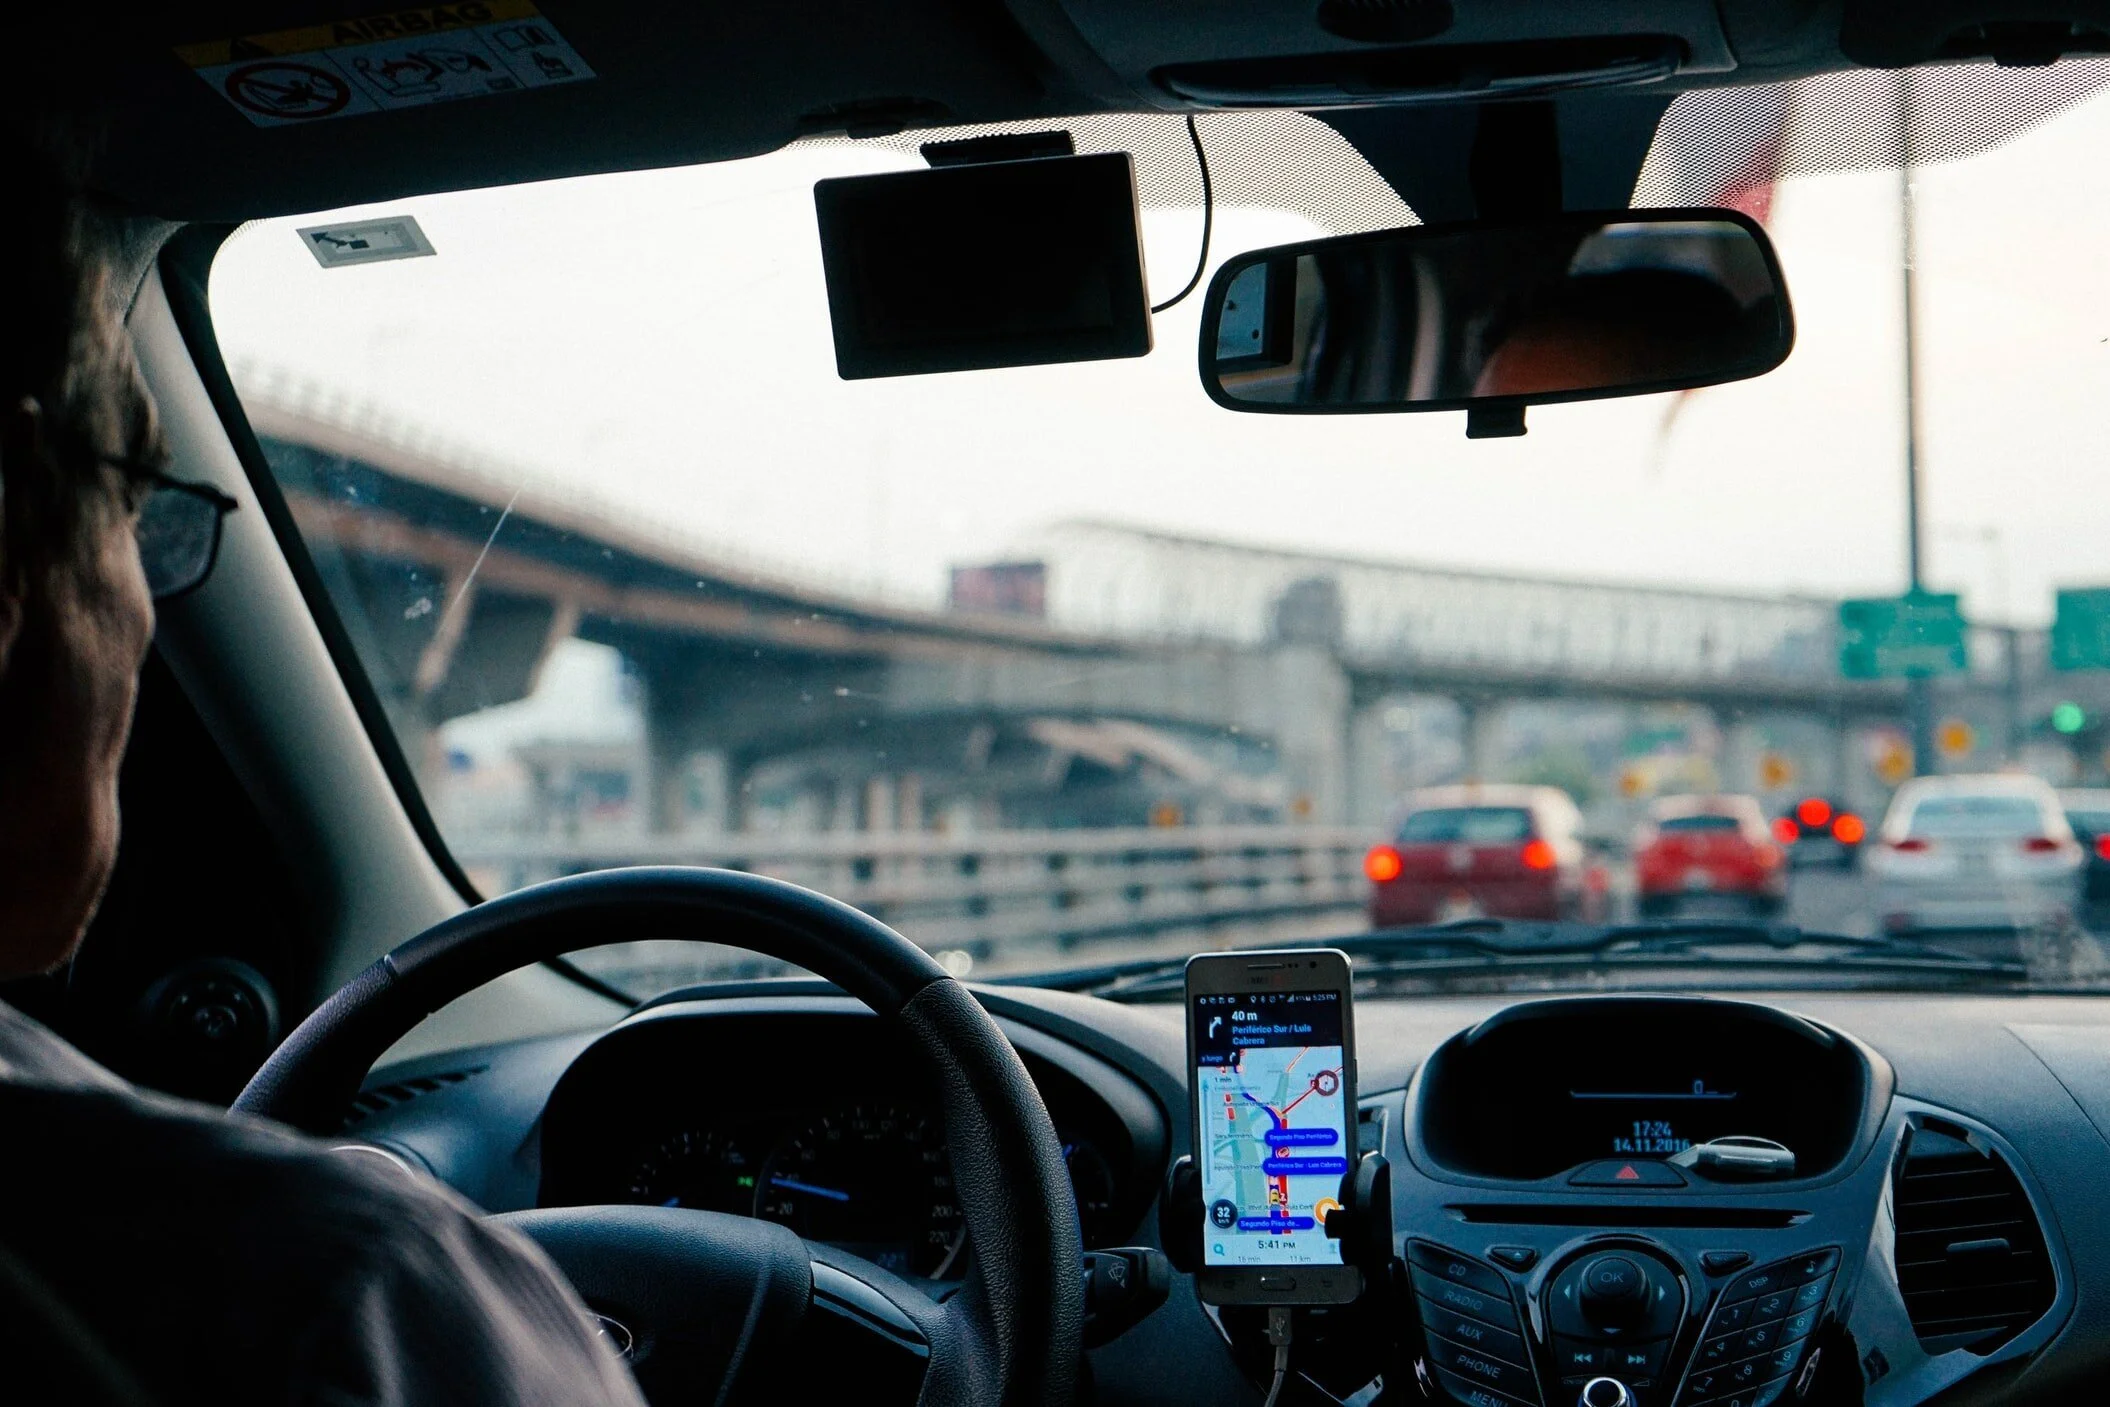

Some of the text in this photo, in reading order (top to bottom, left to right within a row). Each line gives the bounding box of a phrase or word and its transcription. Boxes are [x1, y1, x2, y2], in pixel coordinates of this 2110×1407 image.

[333, 2, 492, 42] AIRBAG
[1232, 1010, 1258, 1021] 40 m
[1232, 1025, 1272, 1035] Periférico
[1273, 1024, 1287, 1034] Sur
[1294, 1023, 1312, 1033] Luis
[1232, 1036, 1265, 1046] Cabrera
[1632, 1120, 1672, 1137] 17:24
[1613, 1137, 1691, 1153] 14.11.2016
[931, 1205, 953, 1218] 200
[1217, 1206, 1231, 1218] 32
[1240, 1219, 1270, 1228] Segundo
[1271, 1219, 1286, 1227] Piso
[1258, 1240, 1279, 1249] 5:41
[1448, 1263, 1467, 1277] CD
[1600, 1271, 1624, 1283] OK
[1748, 1275, 1769, 1289] DSP
[1808, 1285, 1818, 1296] 3
[1444, 1289, 1484, 1311] RADIO
[1769, 1298, 1780, 1309] 2
[1796, 1317, 1805, 1328] 6
[1456, 1323, 1484, 1341] AUX
[1756, 1331, 1767, 1342] 5
[1783, 1350, 1792, 1362] 9
[1456, 1354, 1502, 1378] PHONE
[1743, 1363, 1753, 1376] 8
[1704, 1376, 1713, 1387] 7
